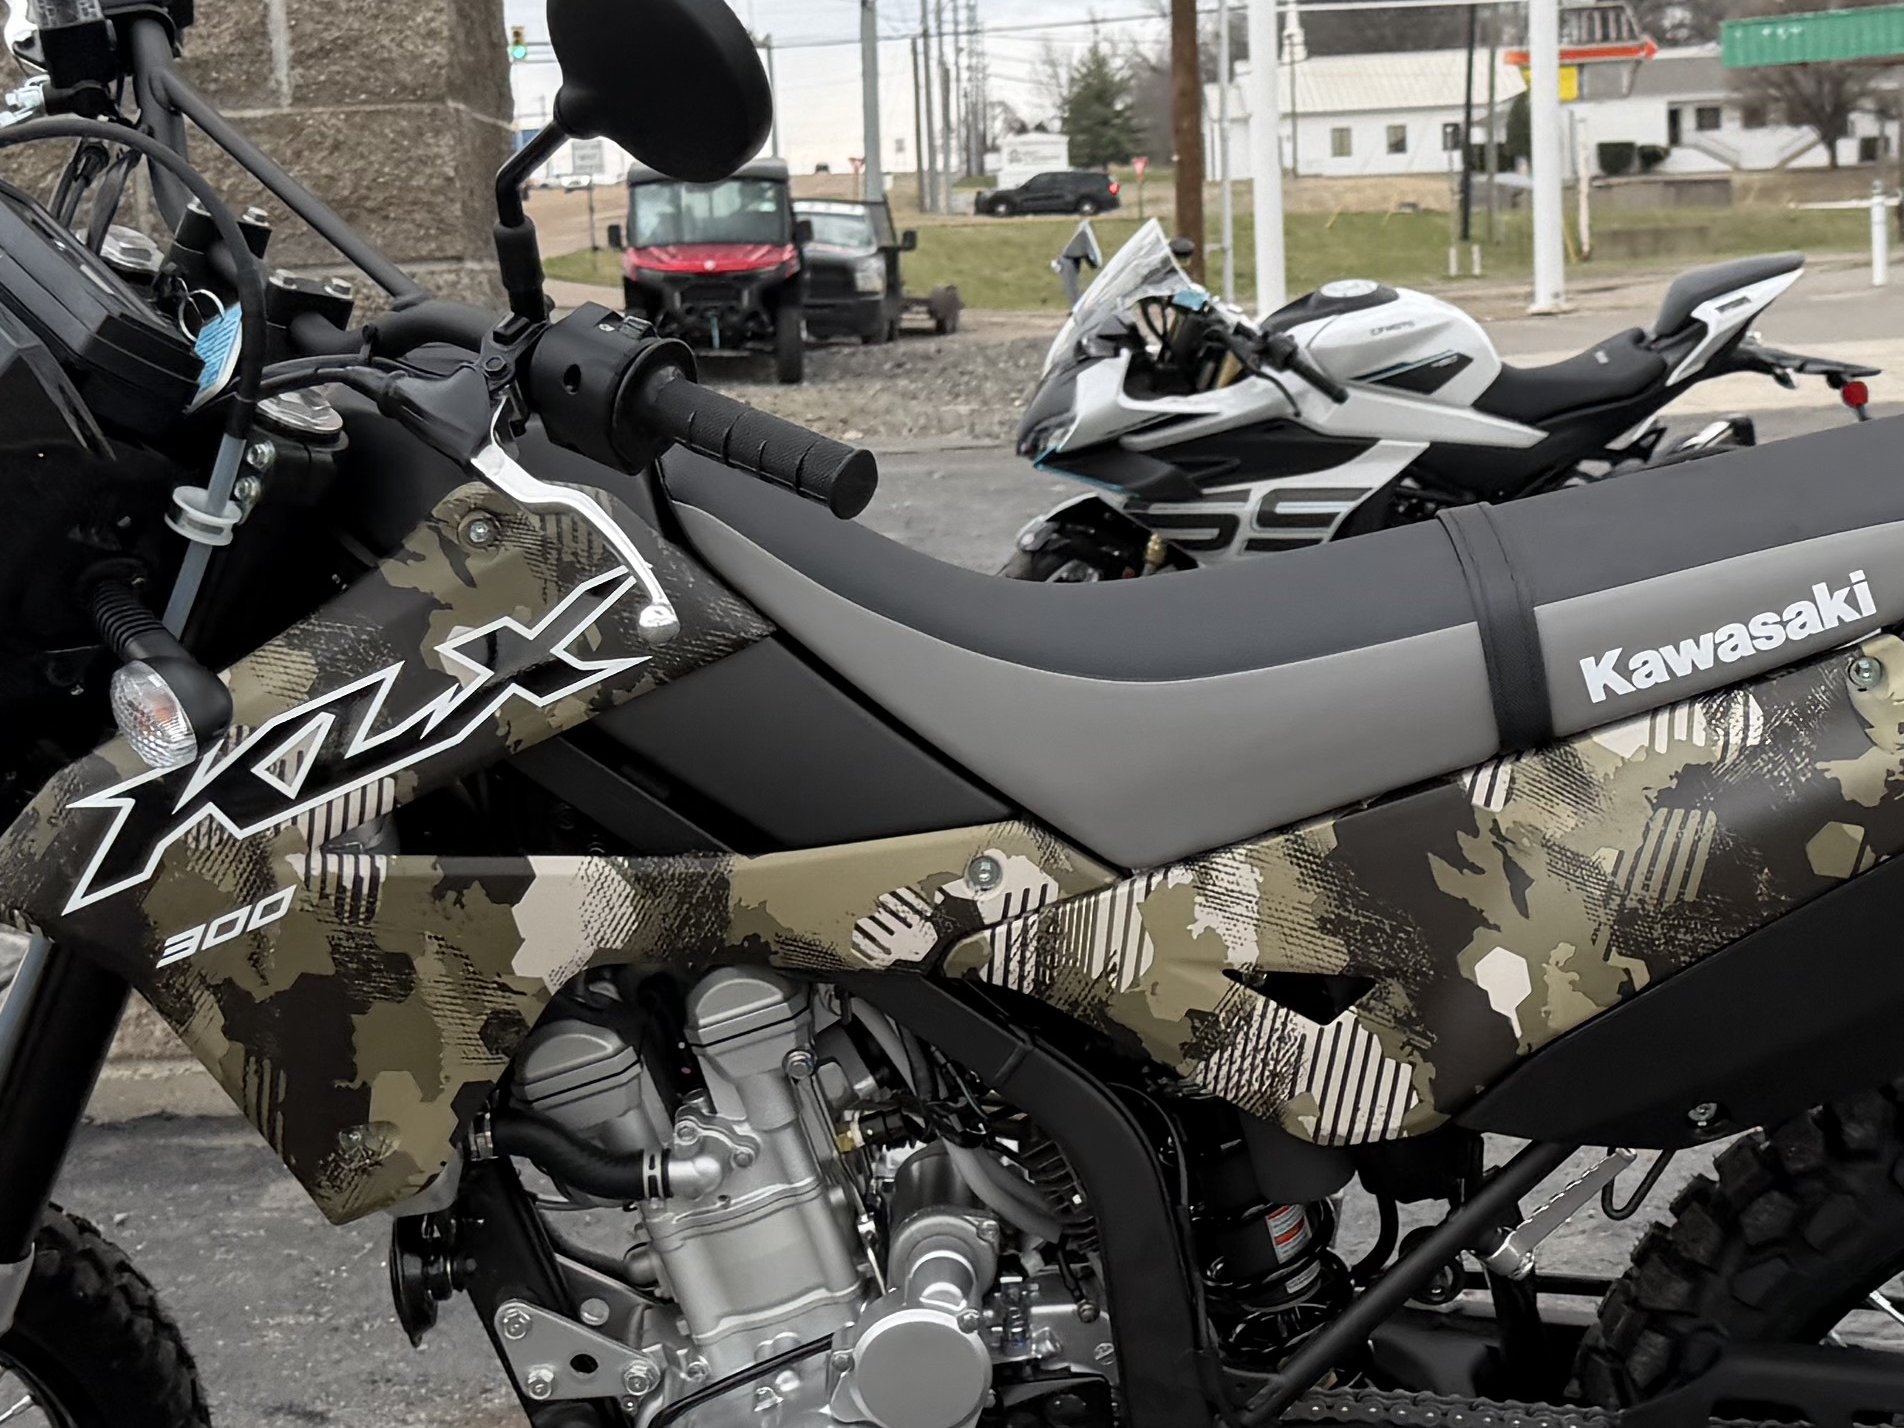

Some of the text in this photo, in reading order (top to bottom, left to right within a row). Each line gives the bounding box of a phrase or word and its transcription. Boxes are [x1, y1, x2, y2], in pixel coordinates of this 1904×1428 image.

[1579, 569, 1877, 704] Kawasaki
[61, 565, 653, 916] KLX
[156, 883, 298, 970] 300
